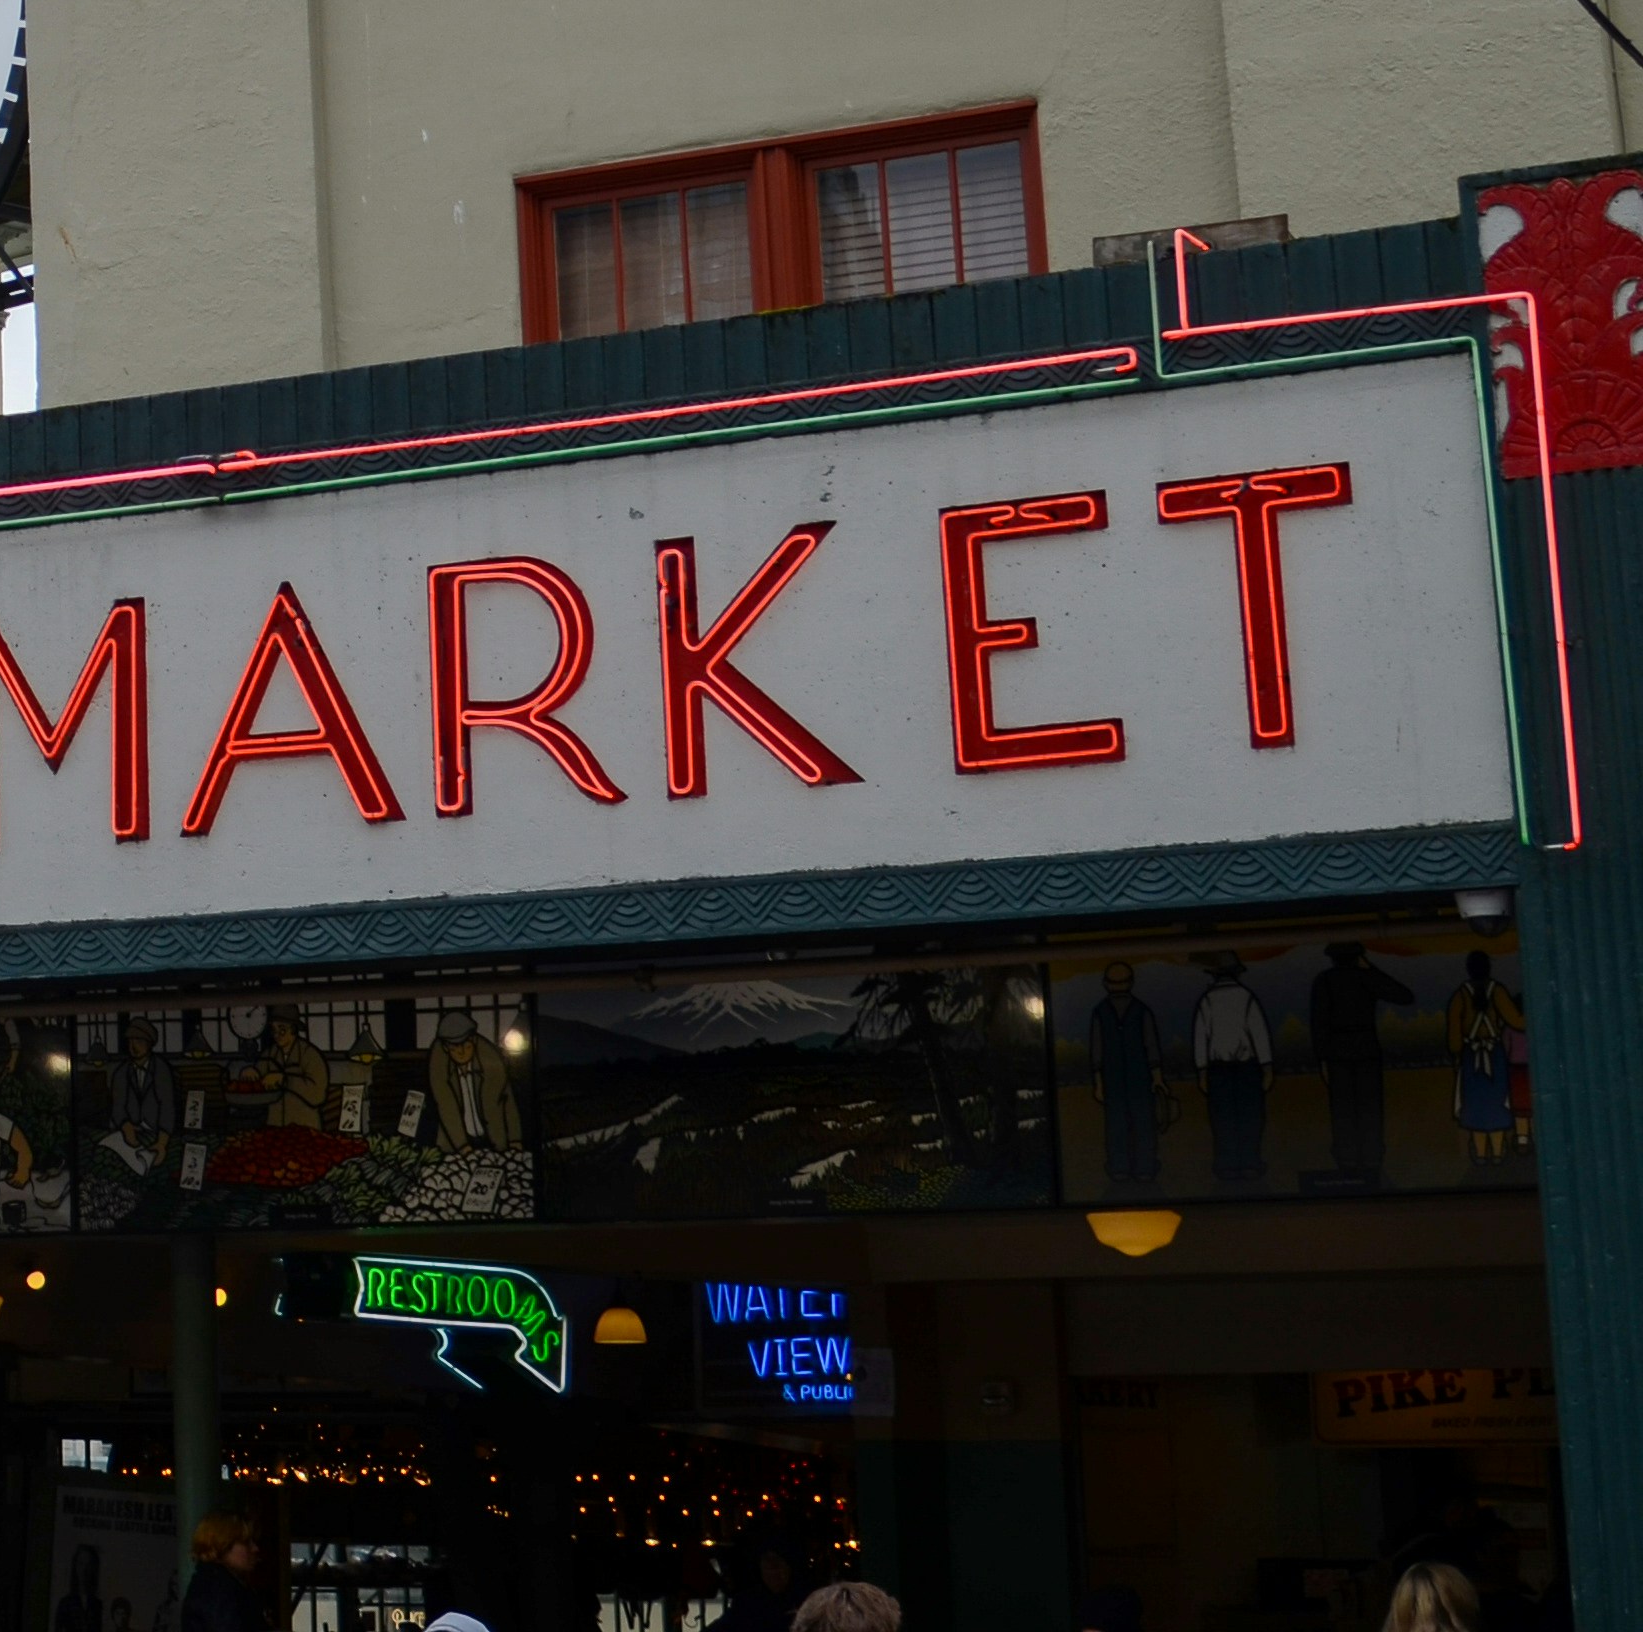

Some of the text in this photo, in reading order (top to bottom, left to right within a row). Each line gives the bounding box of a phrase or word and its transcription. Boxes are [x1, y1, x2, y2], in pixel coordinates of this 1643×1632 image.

[366, 1268, 560, 1363] RESTROOMS
[748, 1337, 850, 1377] VIEW
[783, 1384, 854, 1402] & PUBLI
[1332, 1368, 1467, 1417] PIKE
